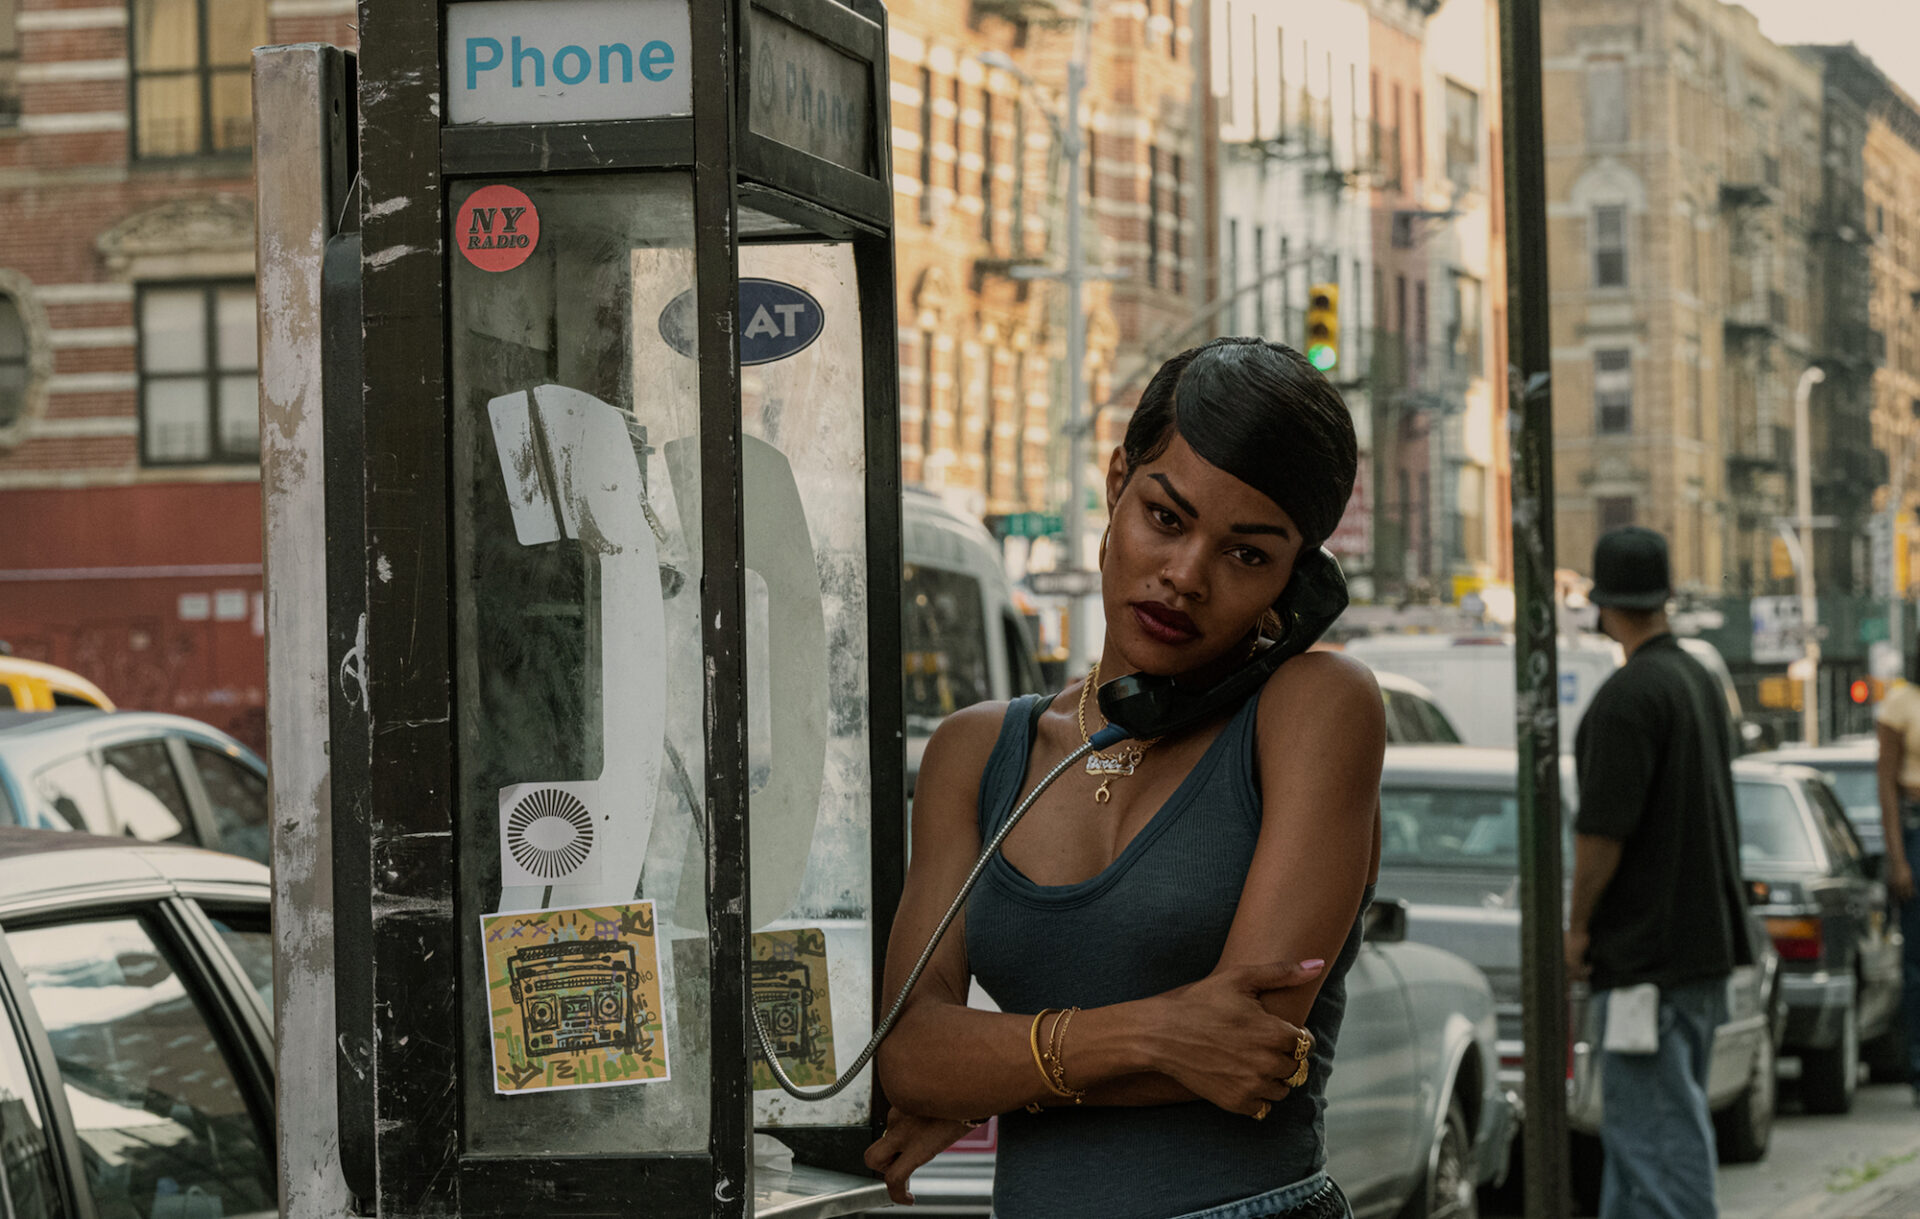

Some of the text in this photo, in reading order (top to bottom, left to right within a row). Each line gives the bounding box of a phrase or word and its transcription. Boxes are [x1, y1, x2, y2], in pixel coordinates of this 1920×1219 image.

[466, 36, 675, 90] Phone
[785, 60, 857, 139] Phone
[468, 206, 526, 233] NY
[467, 234, 530, 250] RADIO
[739, 304, 805, 339] AT
